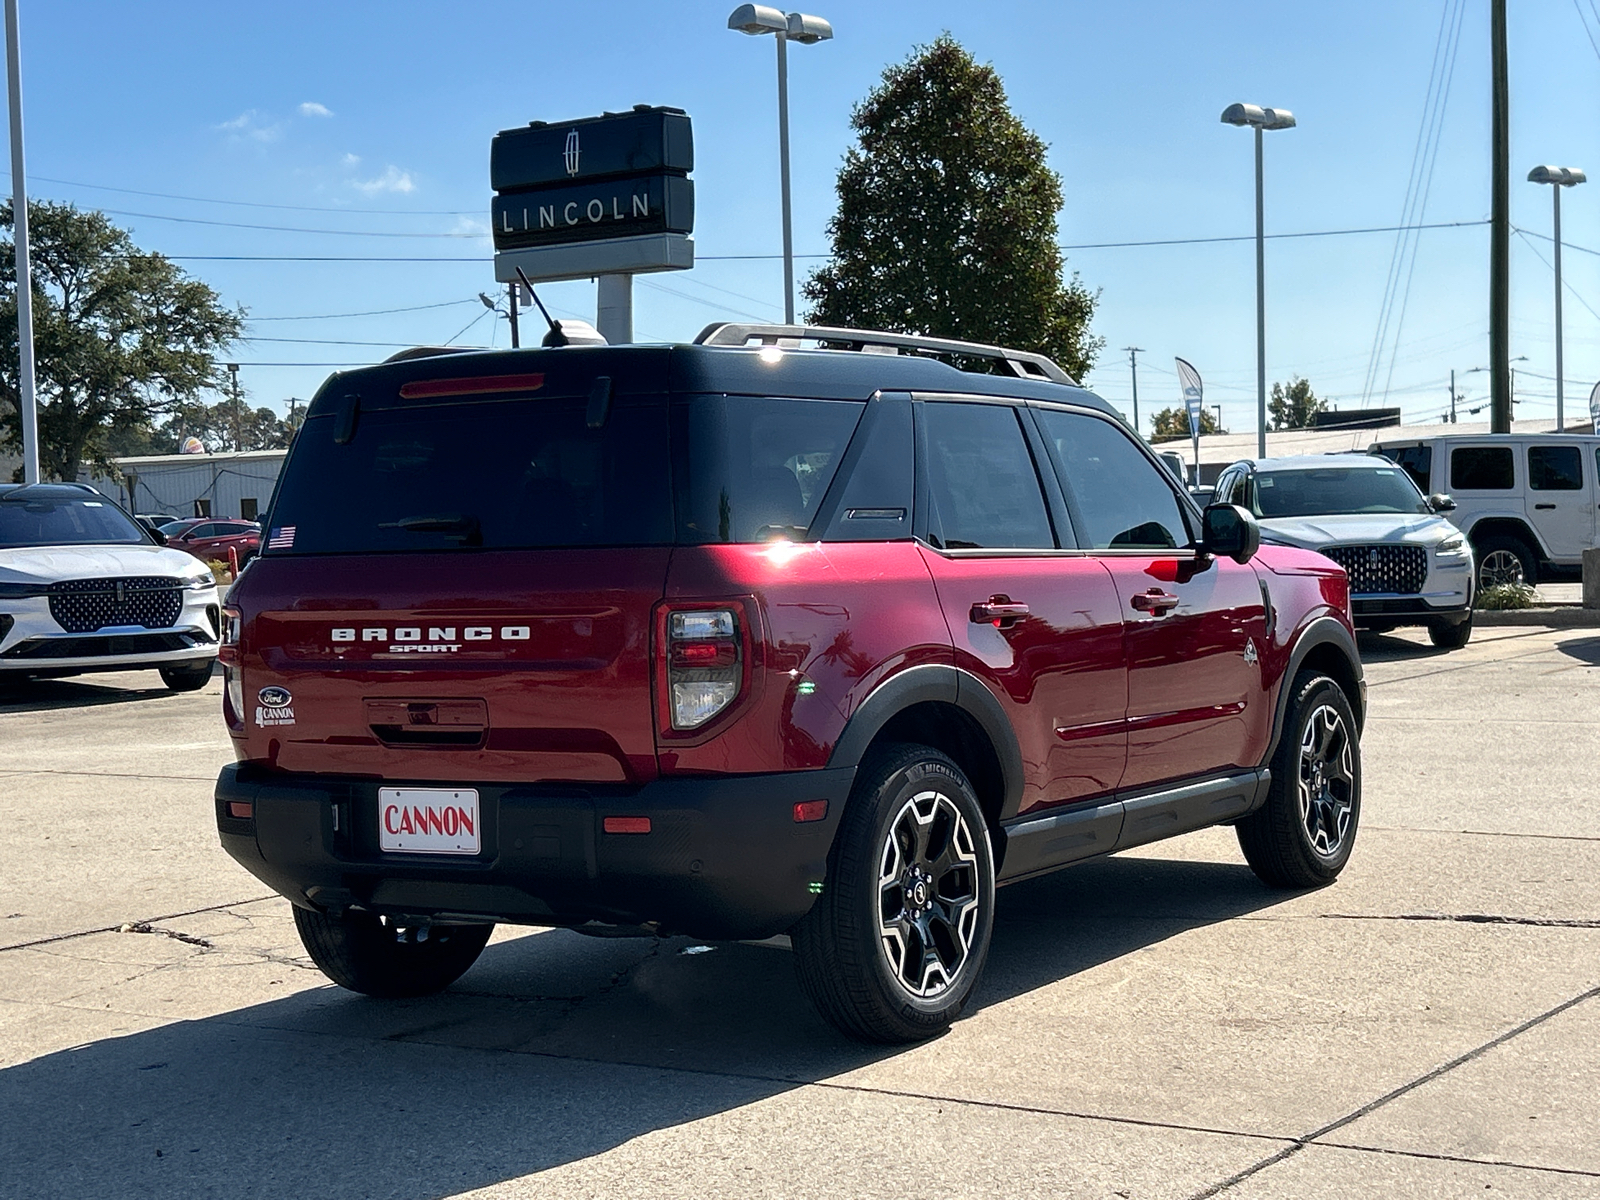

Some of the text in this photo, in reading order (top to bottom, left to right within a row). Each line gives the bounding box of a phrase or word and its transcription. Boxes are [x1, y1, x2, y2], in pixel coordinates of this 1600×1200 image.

[503, 194, 649, 232] LINCOLN
[331, 626, 531, 642] BRONCO
[389, 644, 463, 653] SPORT
[263, 707, 295, 719] CANNON
[925, 763, 963, 786] MICHELIN
[384, 804, 474, 837] CANNON
